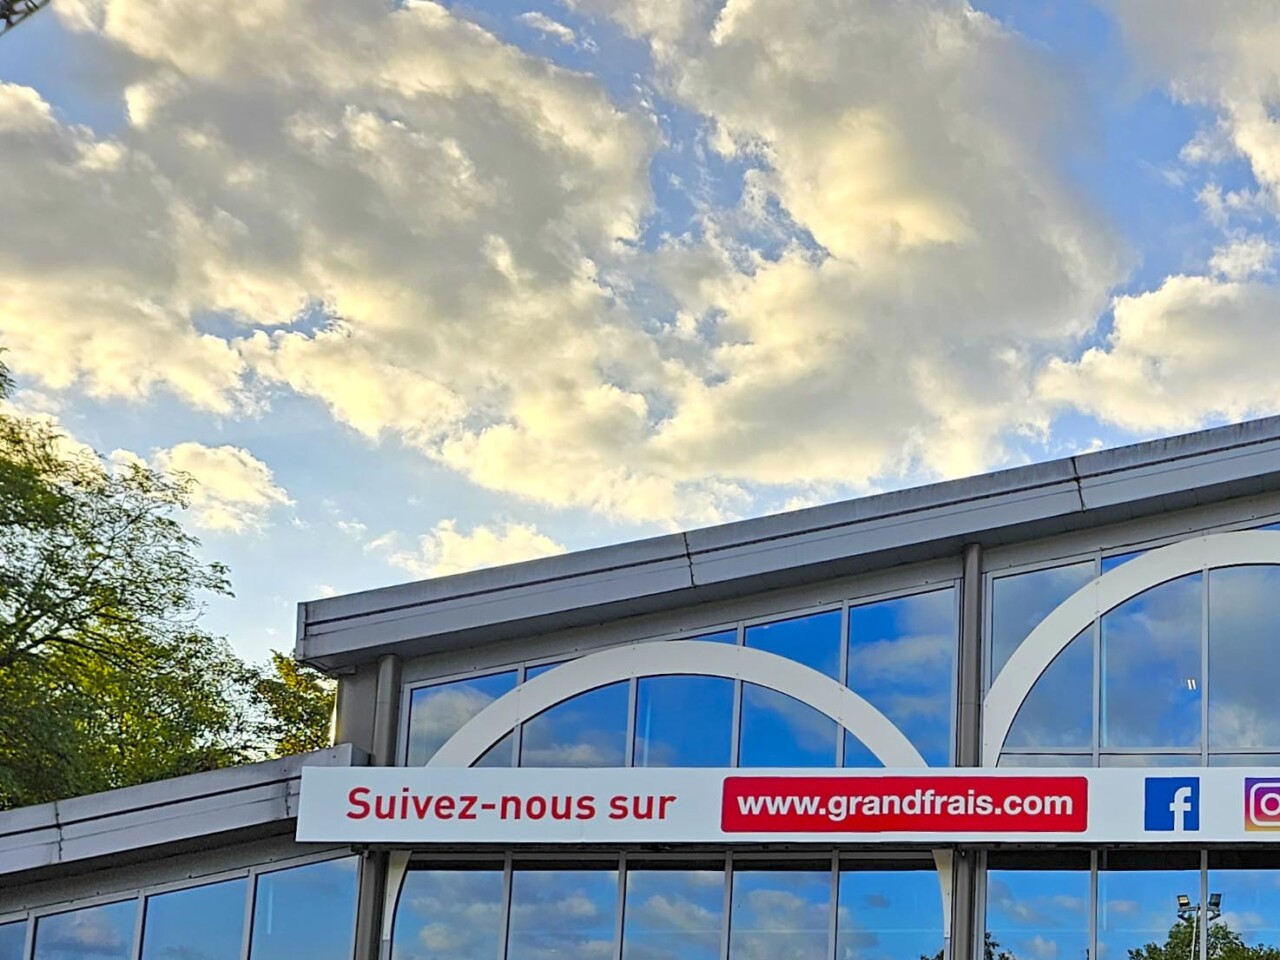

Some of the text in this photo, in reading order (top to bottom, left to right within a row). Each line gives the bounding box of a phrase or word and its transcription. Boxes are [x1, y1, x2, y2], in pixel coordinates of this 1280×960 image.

[346, 786, 1075, 824] Suivez-nous sur www.grandfrais.com
